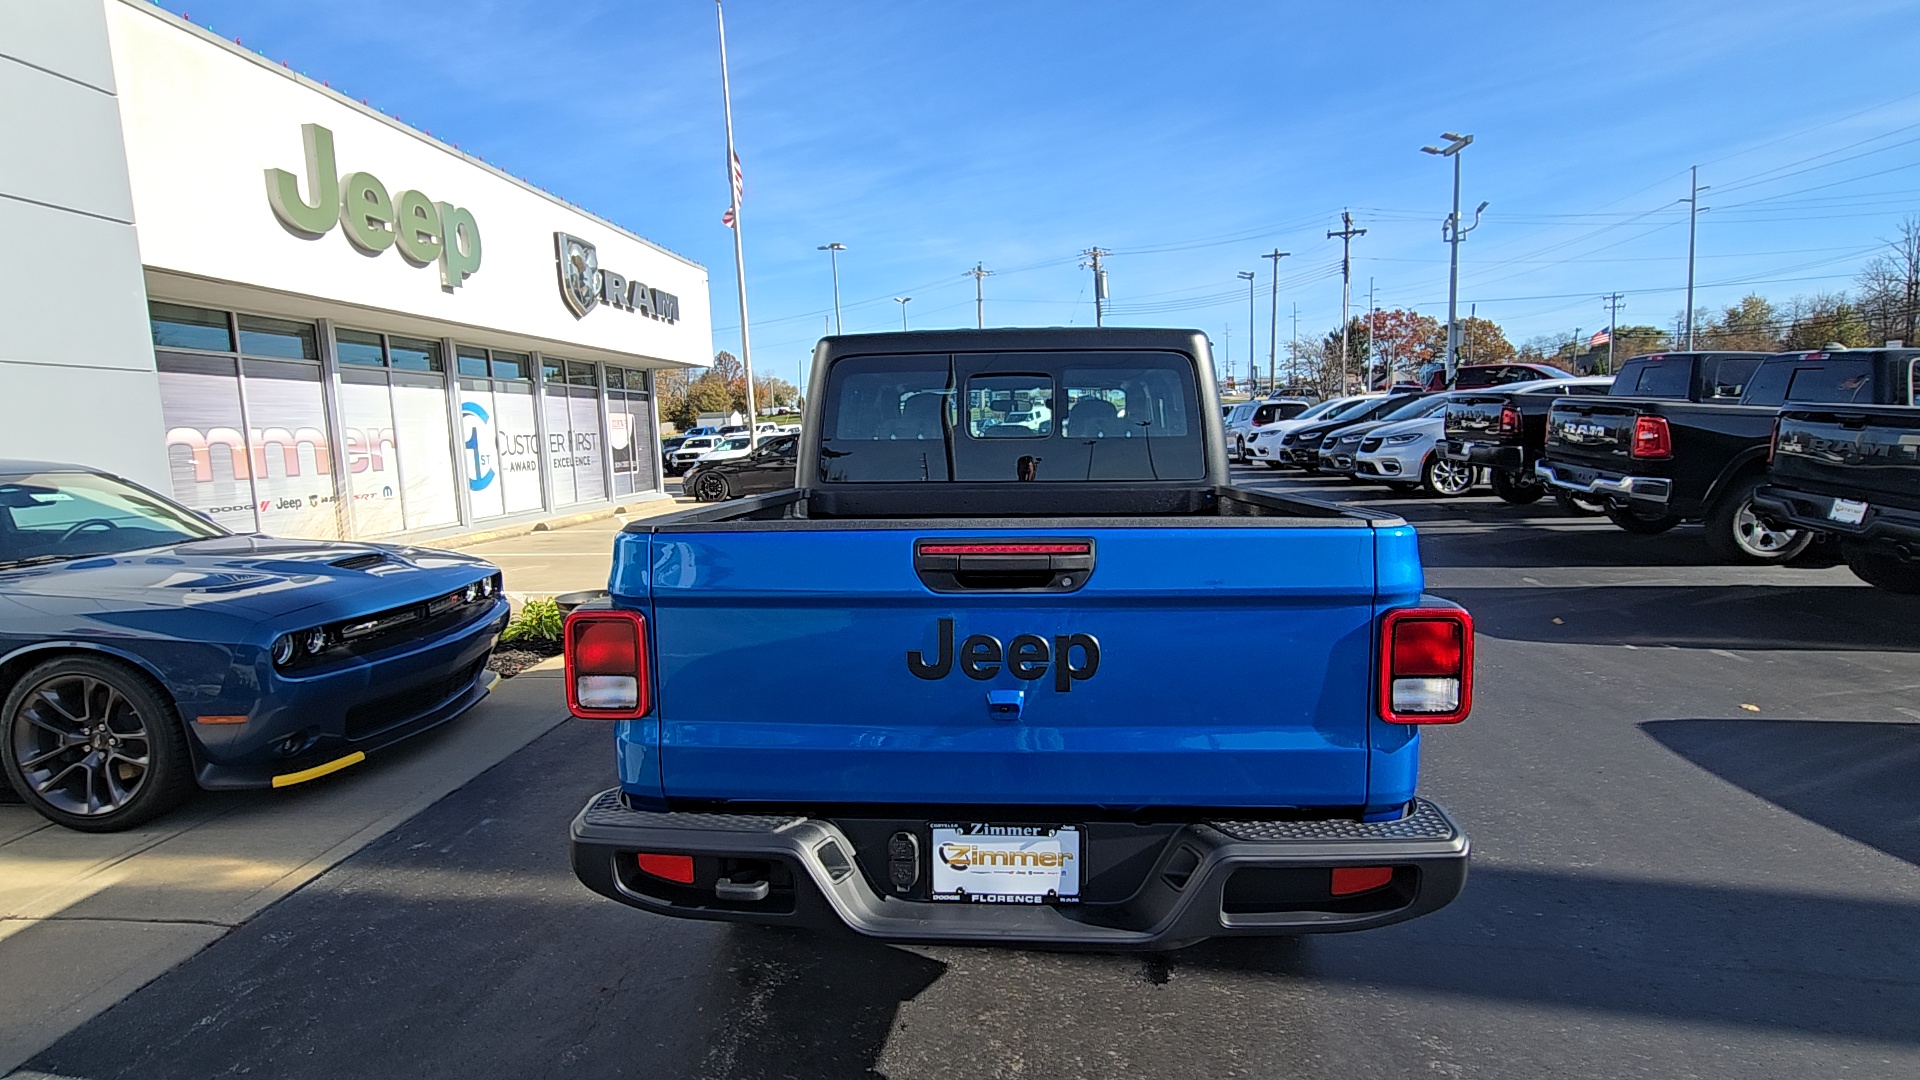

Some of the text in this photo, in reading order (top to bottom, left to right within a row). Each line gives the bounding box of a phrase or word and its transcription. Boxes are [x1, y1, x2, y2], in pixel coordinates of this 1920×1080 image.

[264, 123, 483, 294] Jeep
[600, 269, 681, 325] RAM
[1564, 423, 1605, 437] RAM
[499, 430, 566, 456] CUSTOER
[510, 455, 590, 472] AWARD EXCELENCE
[210, 504, 257, 513] DODG
[276, 497, 302, 510] Jeep
[906, 618, 1101, 693] Jeep
[970, 822, 1042, 836] Zimmer
[947, 844, 1074, 868] Zimmer
[971, 894, 1043, 904] FLORENCE
